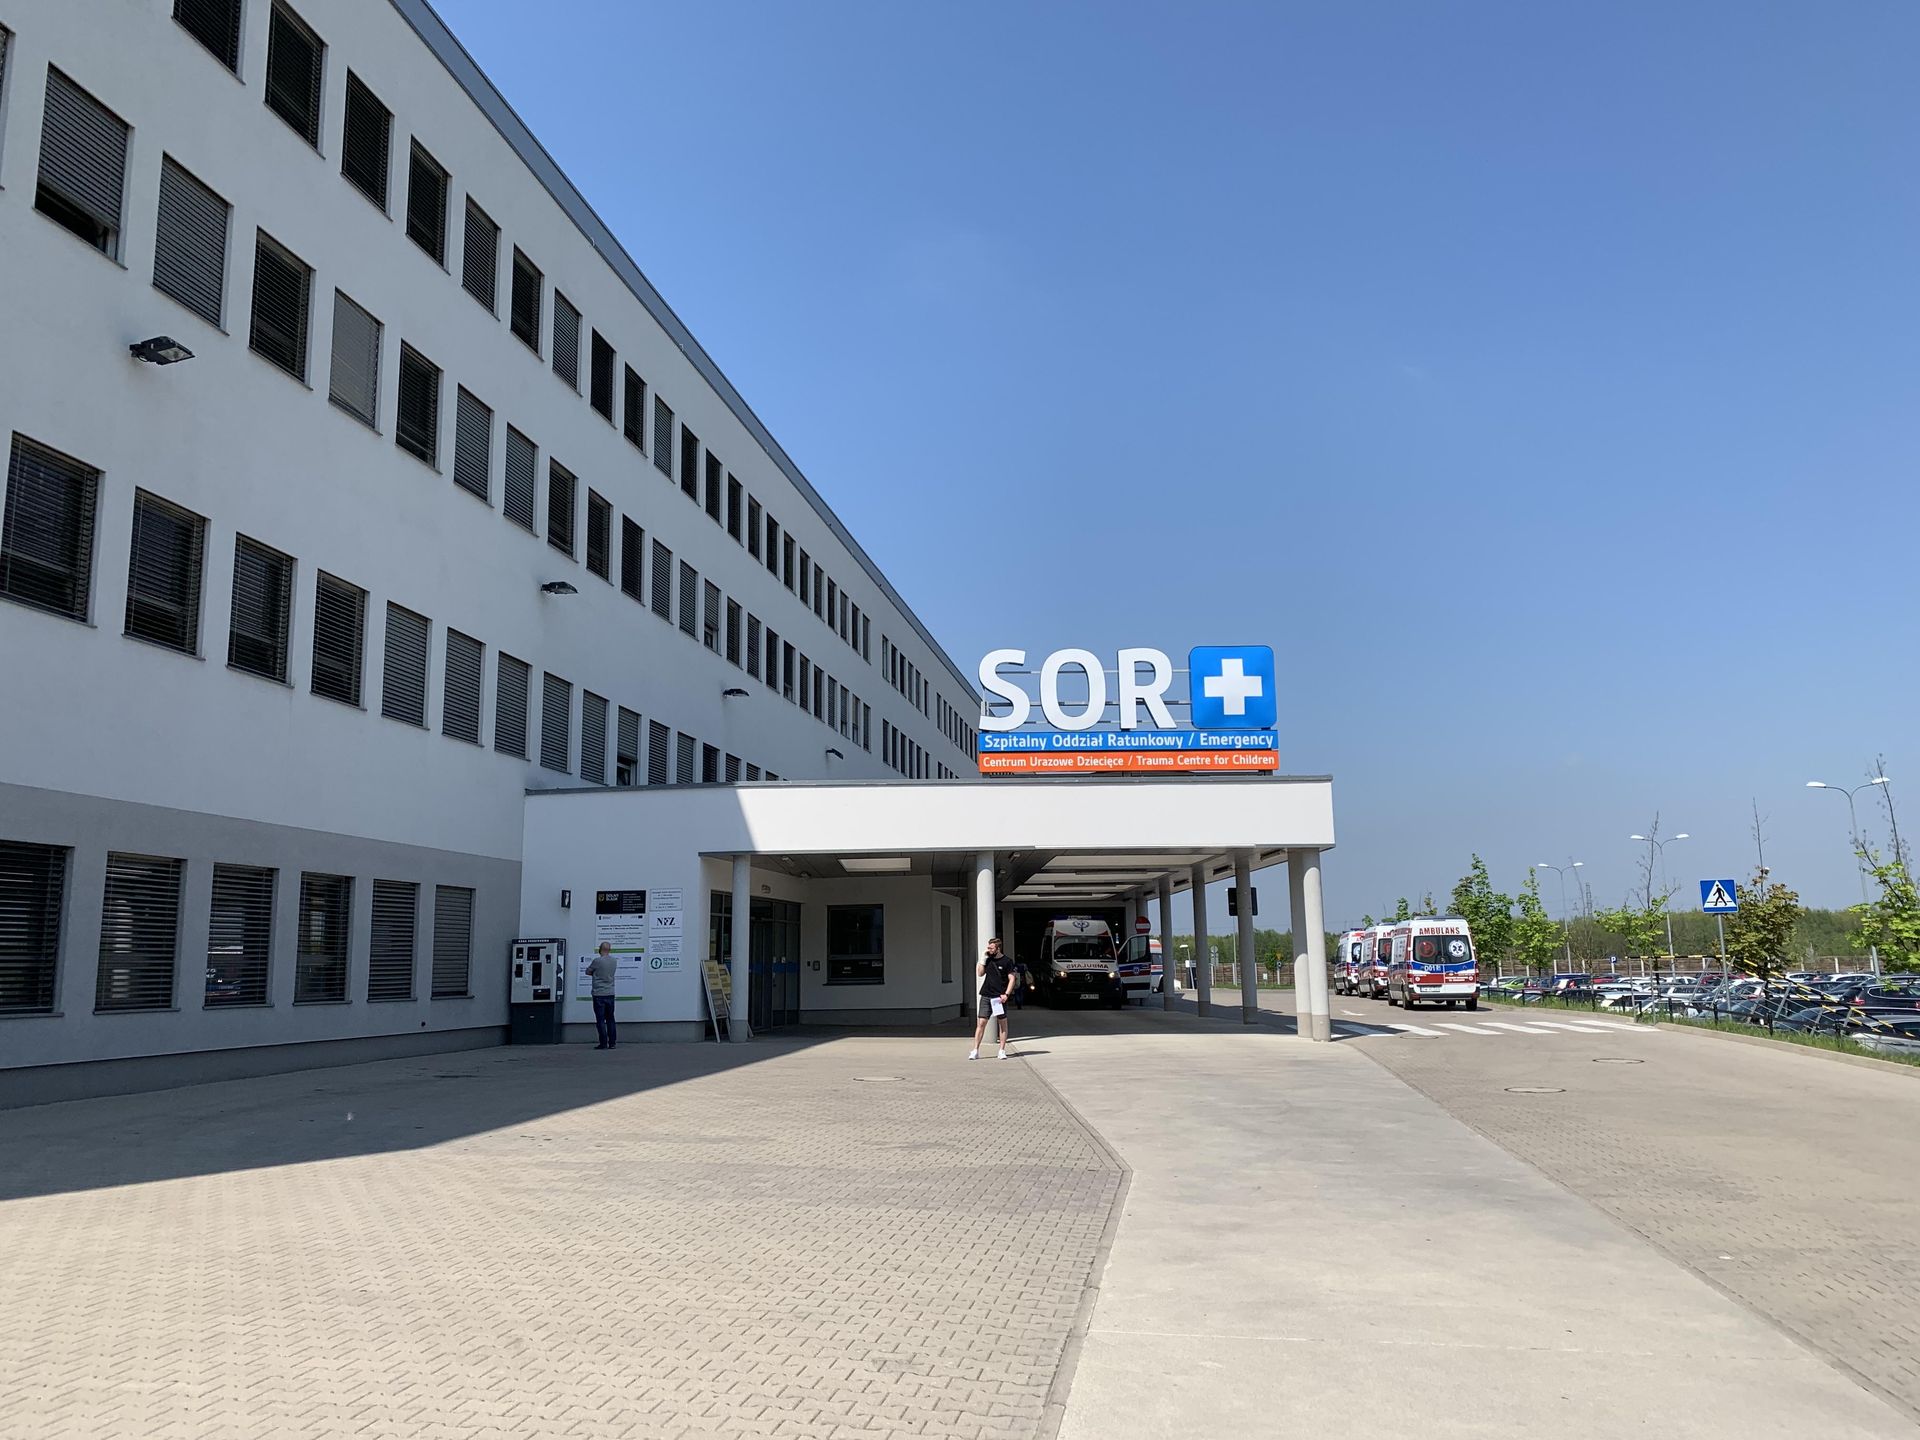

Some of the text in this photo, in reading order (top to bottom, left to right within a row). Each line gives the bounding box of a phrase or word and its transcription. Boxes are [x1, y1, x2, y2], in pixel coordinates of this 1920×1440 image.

[979, 648, 1177, 731] SOR
[984, 732, 1274, 750] Szpitalny Oddział Ratunkowy / Emergency
[983, 754, 1275, 768] Centrum Urazowe Dziecięce / Trauma Centre for Children
[1419, 927, 1460, 935] AMBULANS
